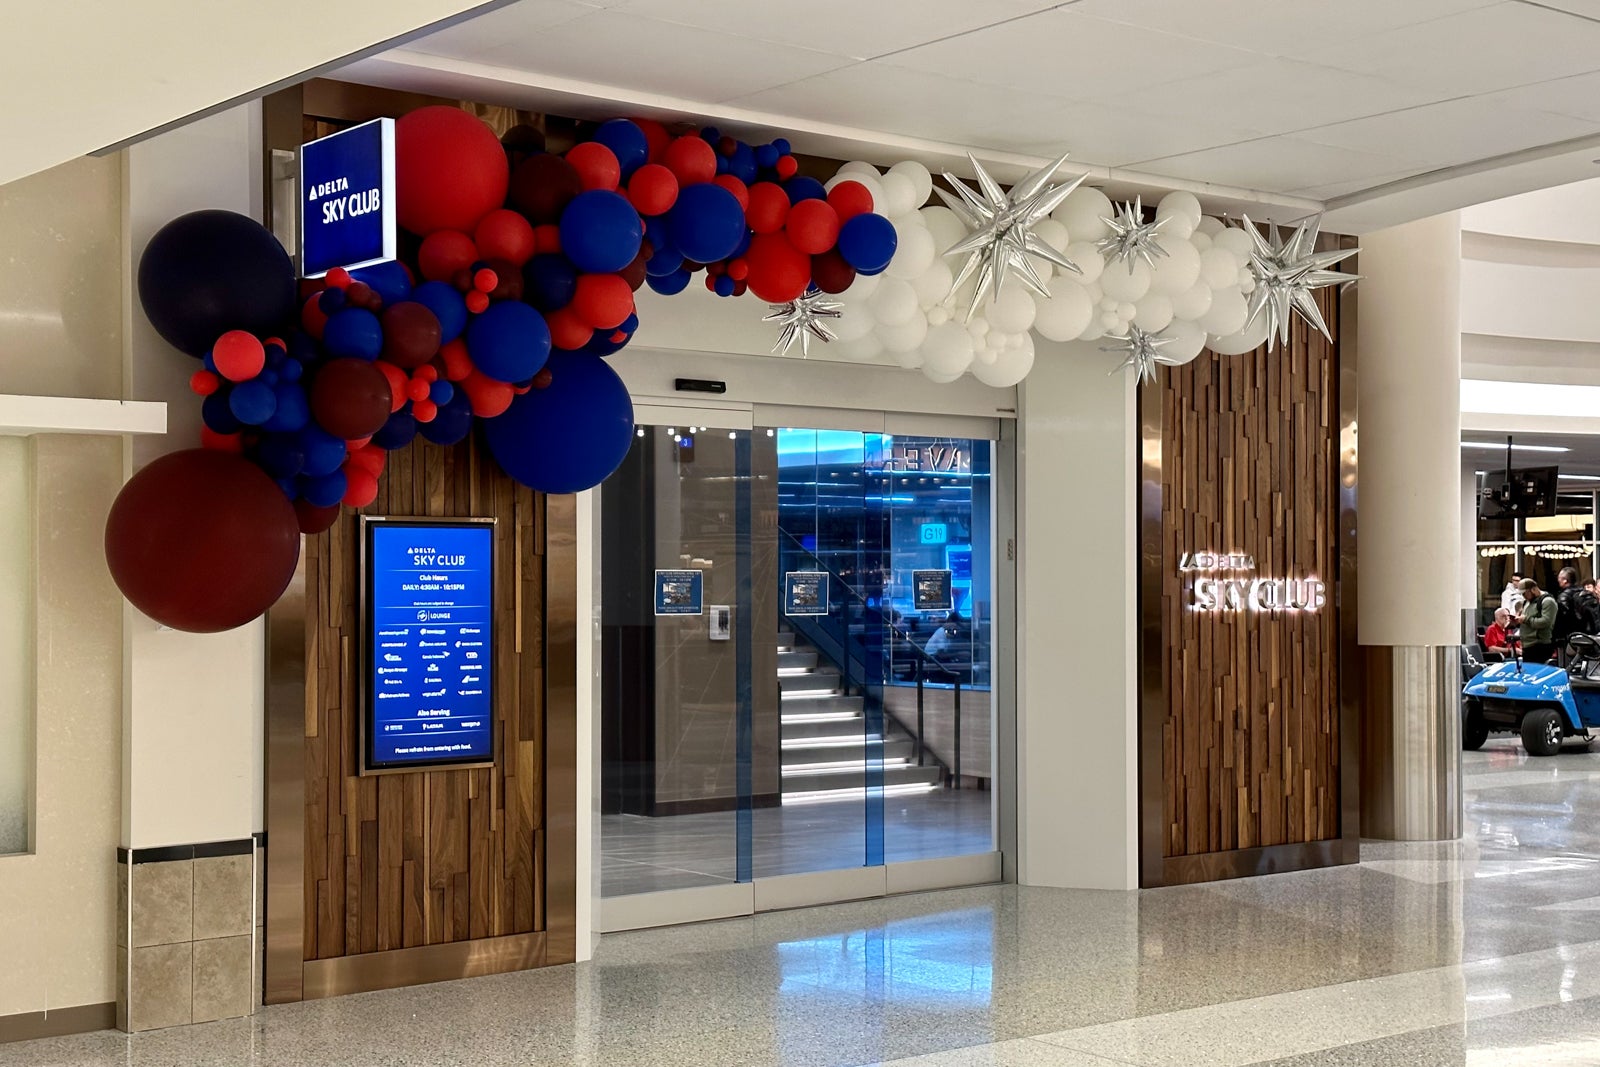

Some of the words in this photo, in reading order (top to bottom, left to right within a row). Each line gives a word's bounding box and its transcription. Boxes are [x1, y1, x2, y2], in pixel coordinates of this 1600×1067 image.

[318, 177, 349, 197] DELTA
[322, 196, 347, 224] SKY
[348, 188, 380, 217] CLUB
[924, 528, 943, 541] G19
[413, 555, 435, 566] SKY
[437, 555, 466, 566] CLUB
[1199, 553, 1256, 569] DELTA
[402, 583, 420, 591] DAILY:
[1199, 579, 1253, 610] SKY
[1256, 579, 1327, 610] CLUB
[1495, 671, 1538, 681] DELTA
